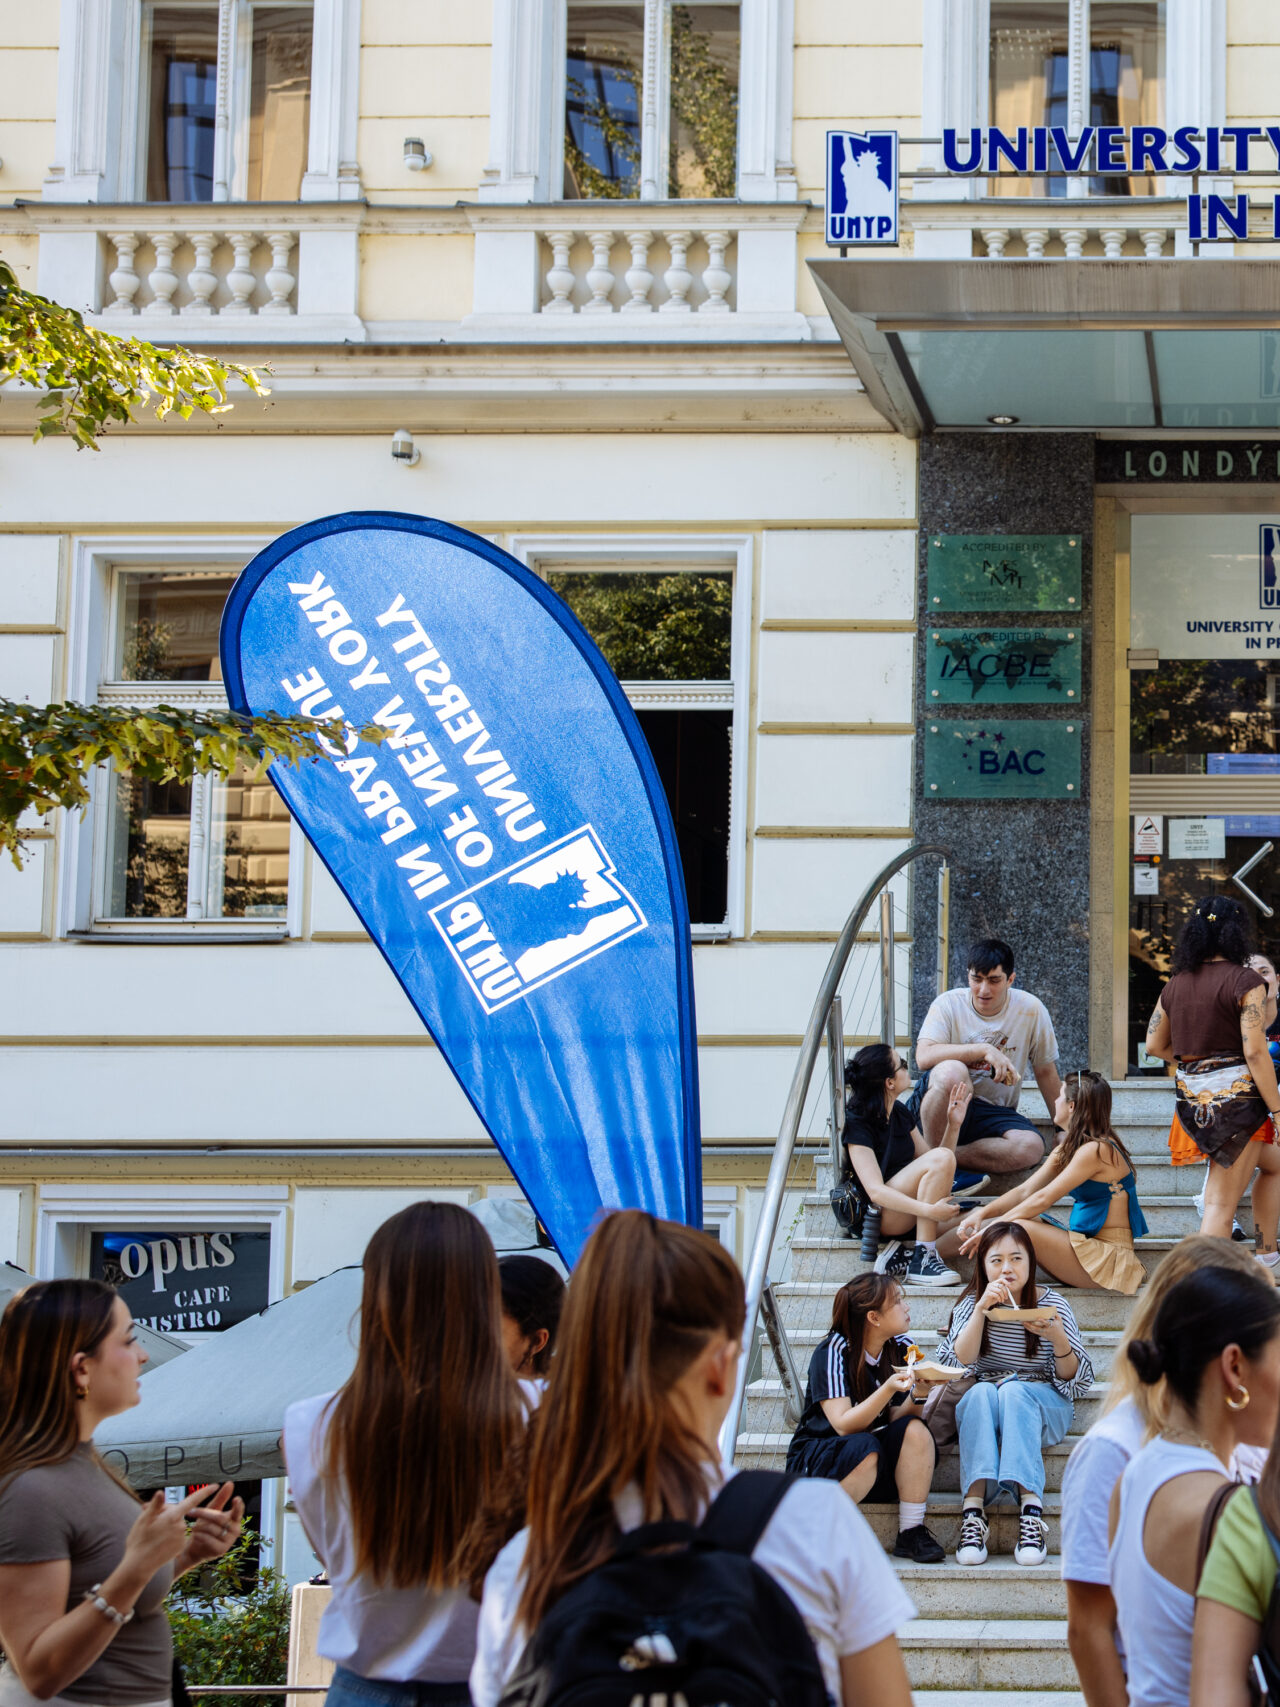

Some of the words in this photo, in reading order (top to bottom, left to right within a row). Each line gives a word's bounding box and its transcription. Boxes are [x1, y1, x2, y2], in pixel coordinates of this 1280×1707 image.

[830, 215, 893, 239] UNYP
[1187, 193, 1248, 240] IN
[961, 542, 1031, 552] ACCREDITED
[1032, 542, 1048, 552] BY
[1186, 621, 1274, 633] UNIVERSITY
[1245, 637, 1261, 649] IN
[940, 653, 1054, 678] IACBE
[979, 749, 1046, 775] BAC
[120, 1232, 236, 1293] opus
[174, 1285, 231, 1308] CAFE
